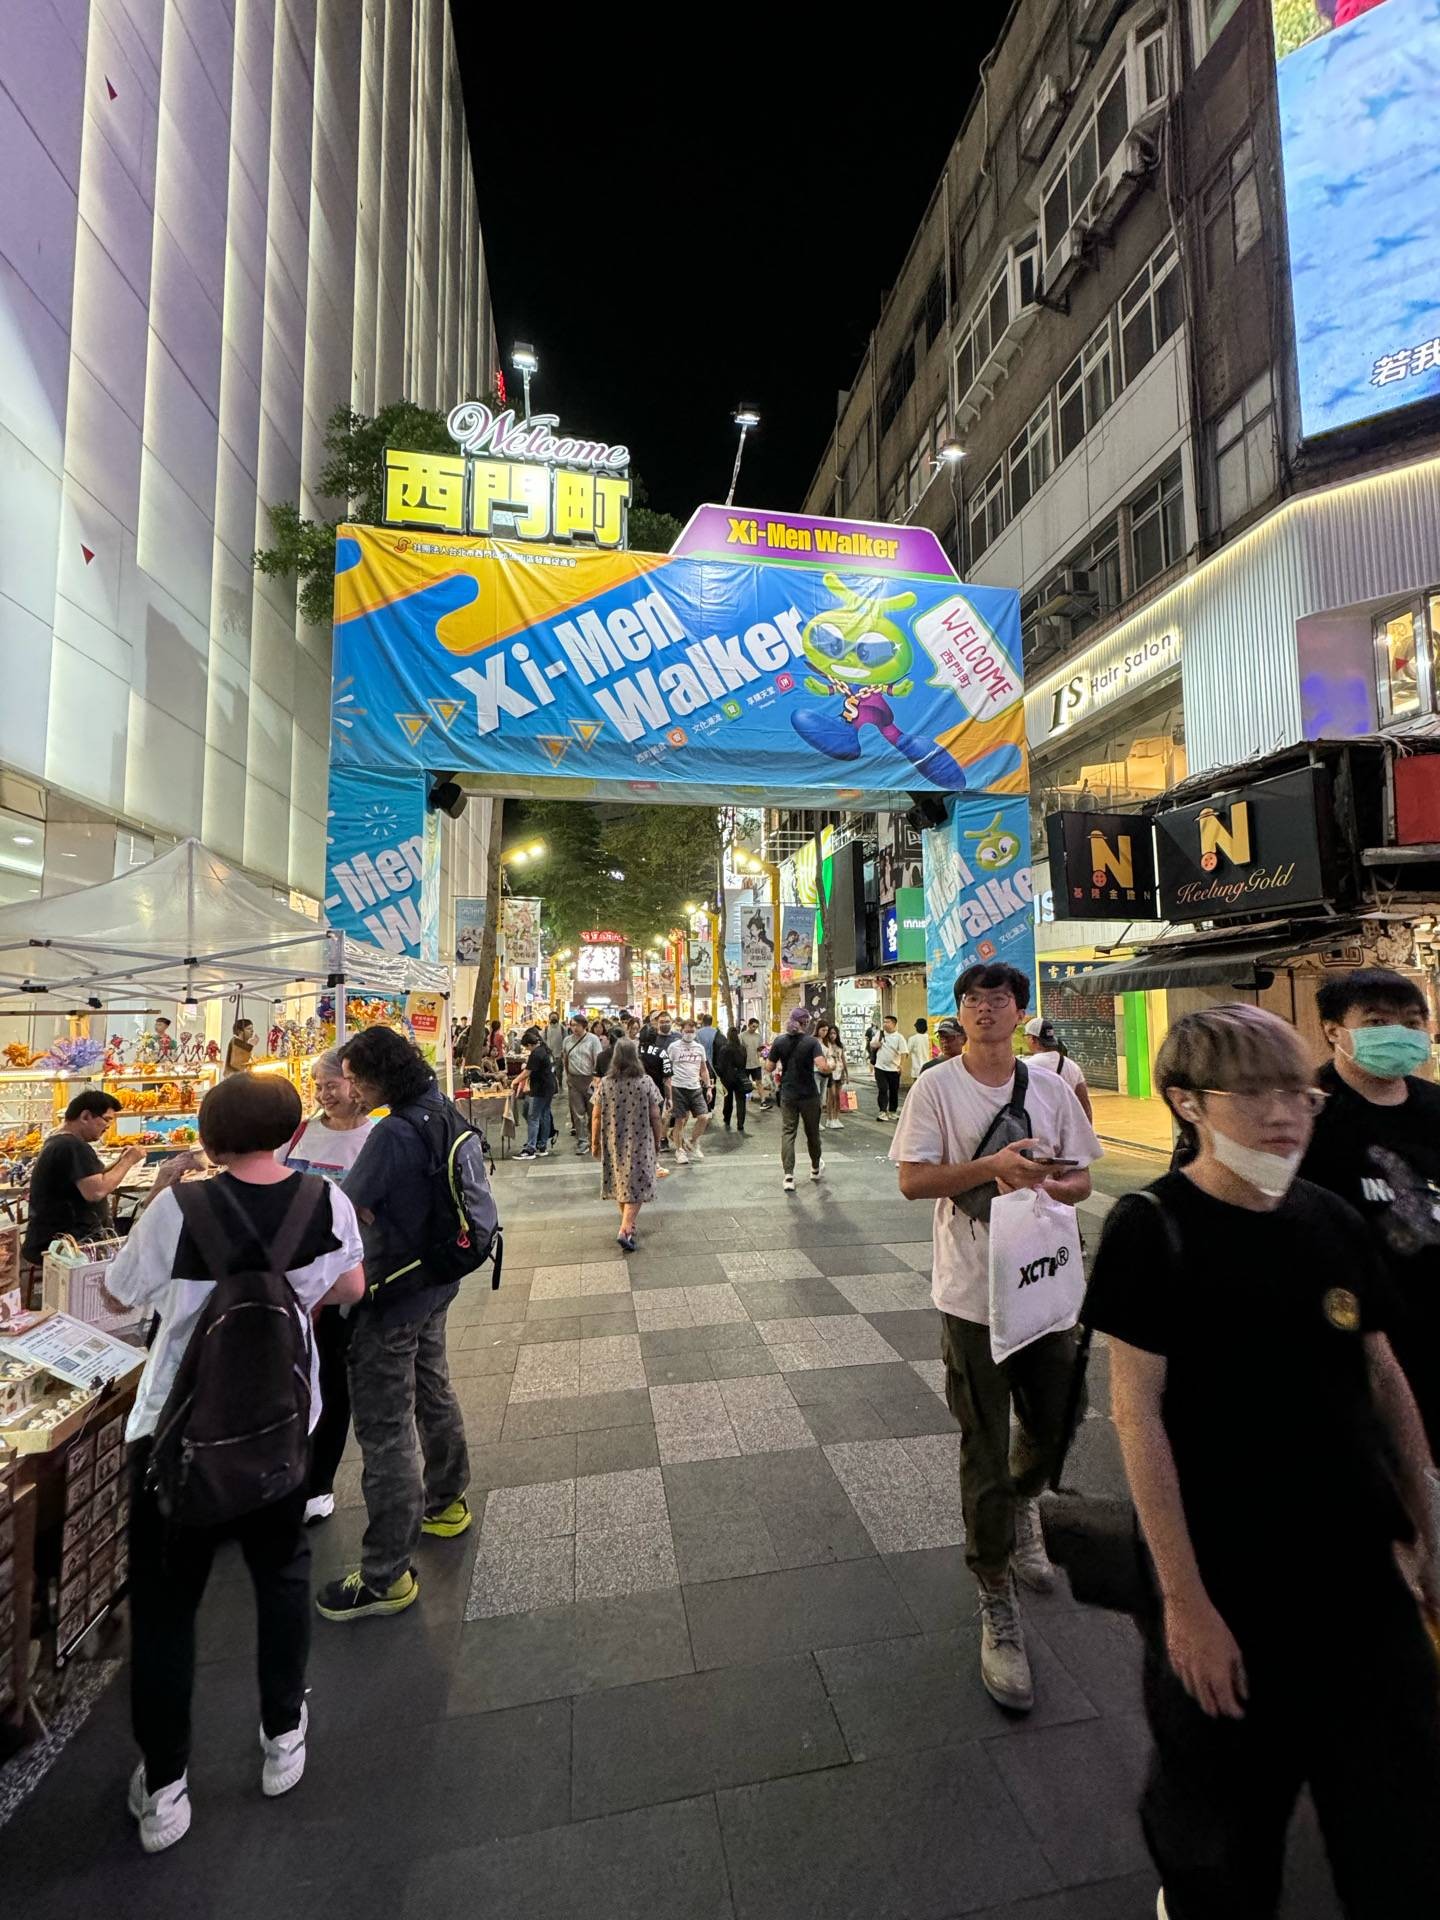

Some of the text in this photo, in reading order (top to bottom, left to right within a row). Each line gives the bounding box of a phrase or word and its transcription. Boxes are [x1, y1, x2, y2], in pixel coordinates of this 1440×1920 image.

[447, 401, 630, 468] Welcome
[383, 447, 633, 545] 西門町
[727, 517, 899, 559] Xi-Men Walker
[450, 592, 686, 736] Xi-Men
[593, 605, 805, 743] Walker
[940, 647, 972, 689] 西門町
[941, 608, 1013, 702] WELCOME
[1089, 667, 1120, 694] Hair
[1124, 632, 1173, 675] Salon
[1033, 890, 1055, 924] IS
[1177, 862, 1296, 904] Keelung Gold
[362, 896, 422, 954] W
